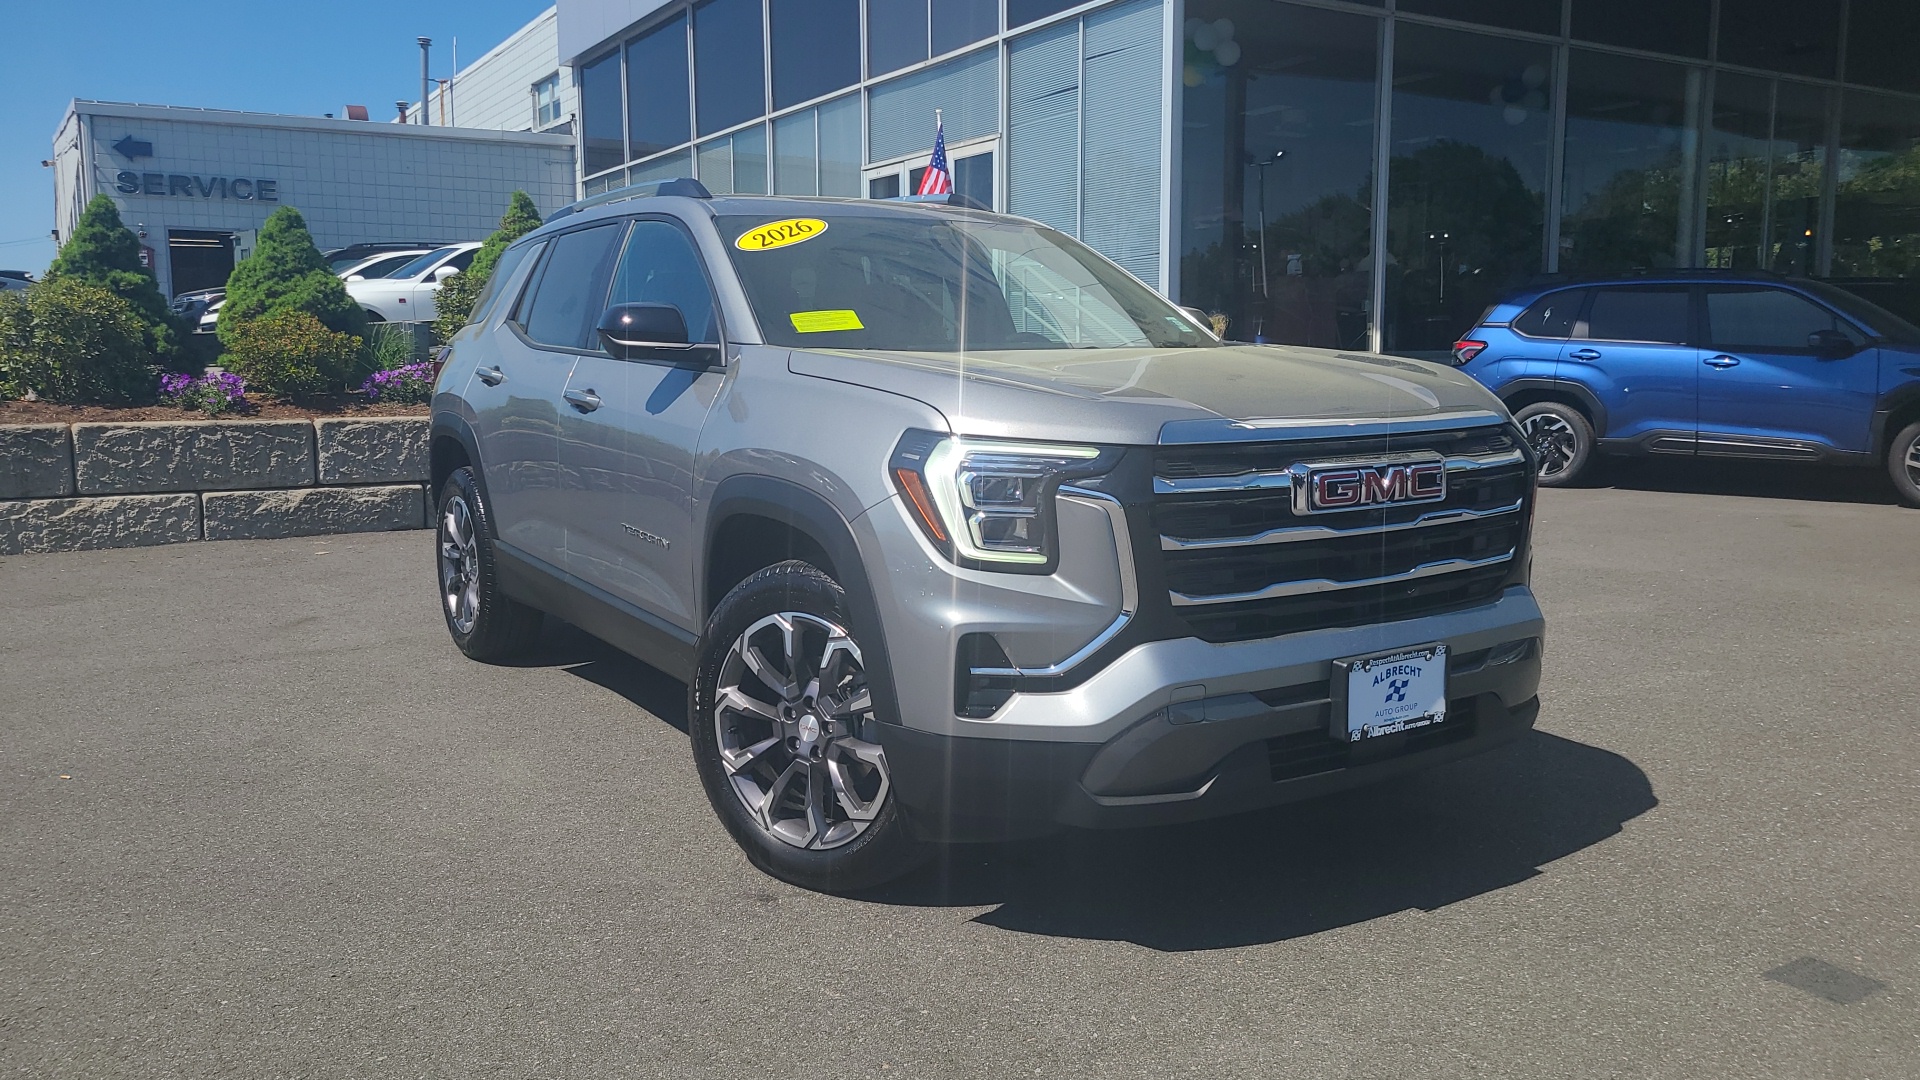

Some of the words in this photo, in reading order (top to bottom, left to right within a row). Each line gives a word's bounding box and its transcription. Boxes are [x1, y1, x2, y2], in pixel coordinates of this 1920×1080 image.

[116, 171, 278, 201] SERVICE
[752, 220, 813, 247] 2026
[1314, 464, 1443, 506] GMC
[1372, 665, 1422, 687] ALBRECHT
[1375, 708, 1393, 718] AUTO
[1394, 702, 1418, 713] GROUP
[1367, 720, 1405, 738] Albrecht
